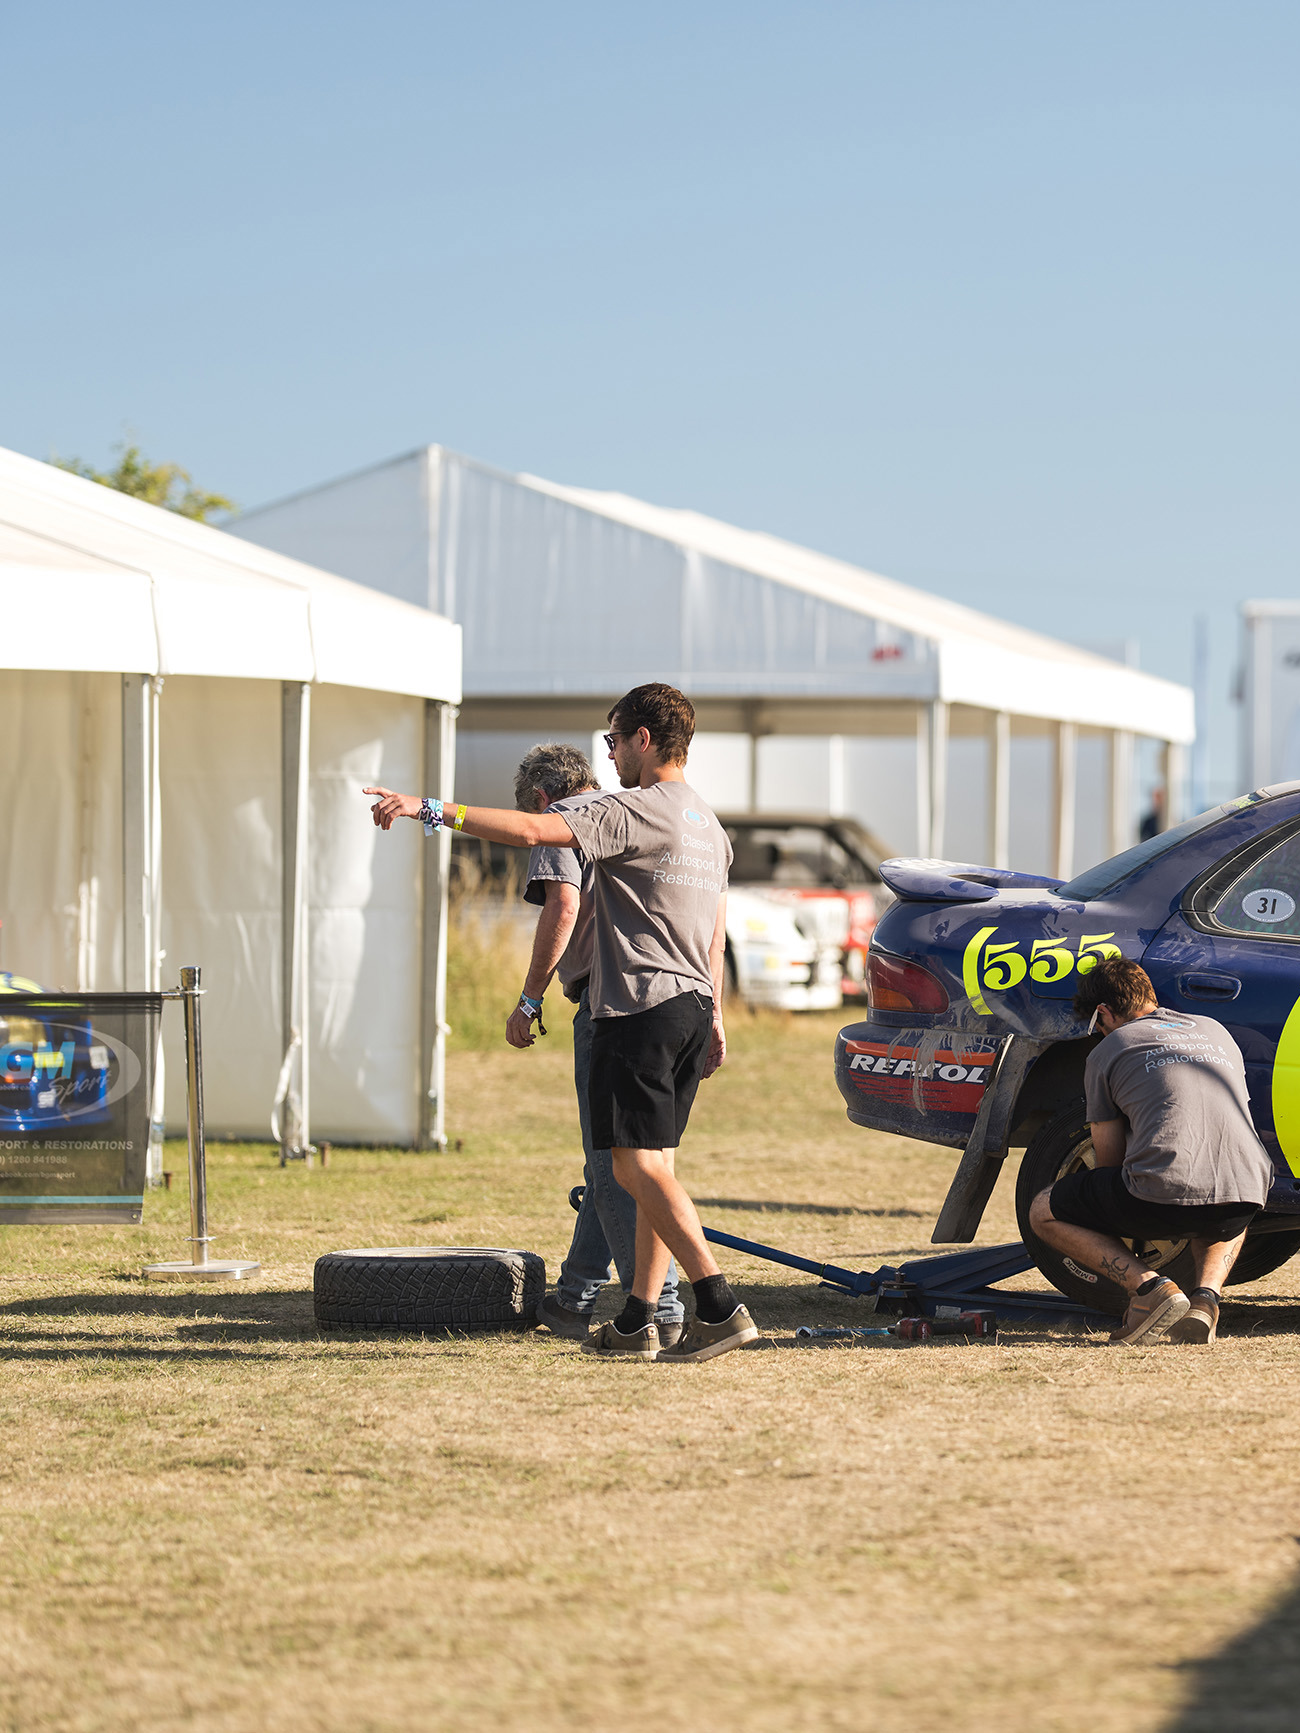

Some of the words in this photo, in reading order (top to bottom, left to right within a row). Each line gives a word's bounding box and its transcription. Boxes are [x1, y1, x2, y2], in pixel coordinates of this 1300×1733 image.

[681, 833, 714, 853] Classic
[659, 851, 715, 872] Autosport
[1257, 897, 1277, 914] 31
[1155, 1032, 1209, 1041] Classic
[1145, 1042, 1216, 1060] Autosport
[1217, 1045, 1227, 1057] &
[1144, 1053, 1235, 1073] Restorations
[48, 1070, 112, 1105] Sport
[32, 1140, 41, 1150] &
[44, 1140, 134, 1150] RESTORATIONS
[9, 1155, 31, 1164] 1280
[33, 1155, 68, 1164] 841988
